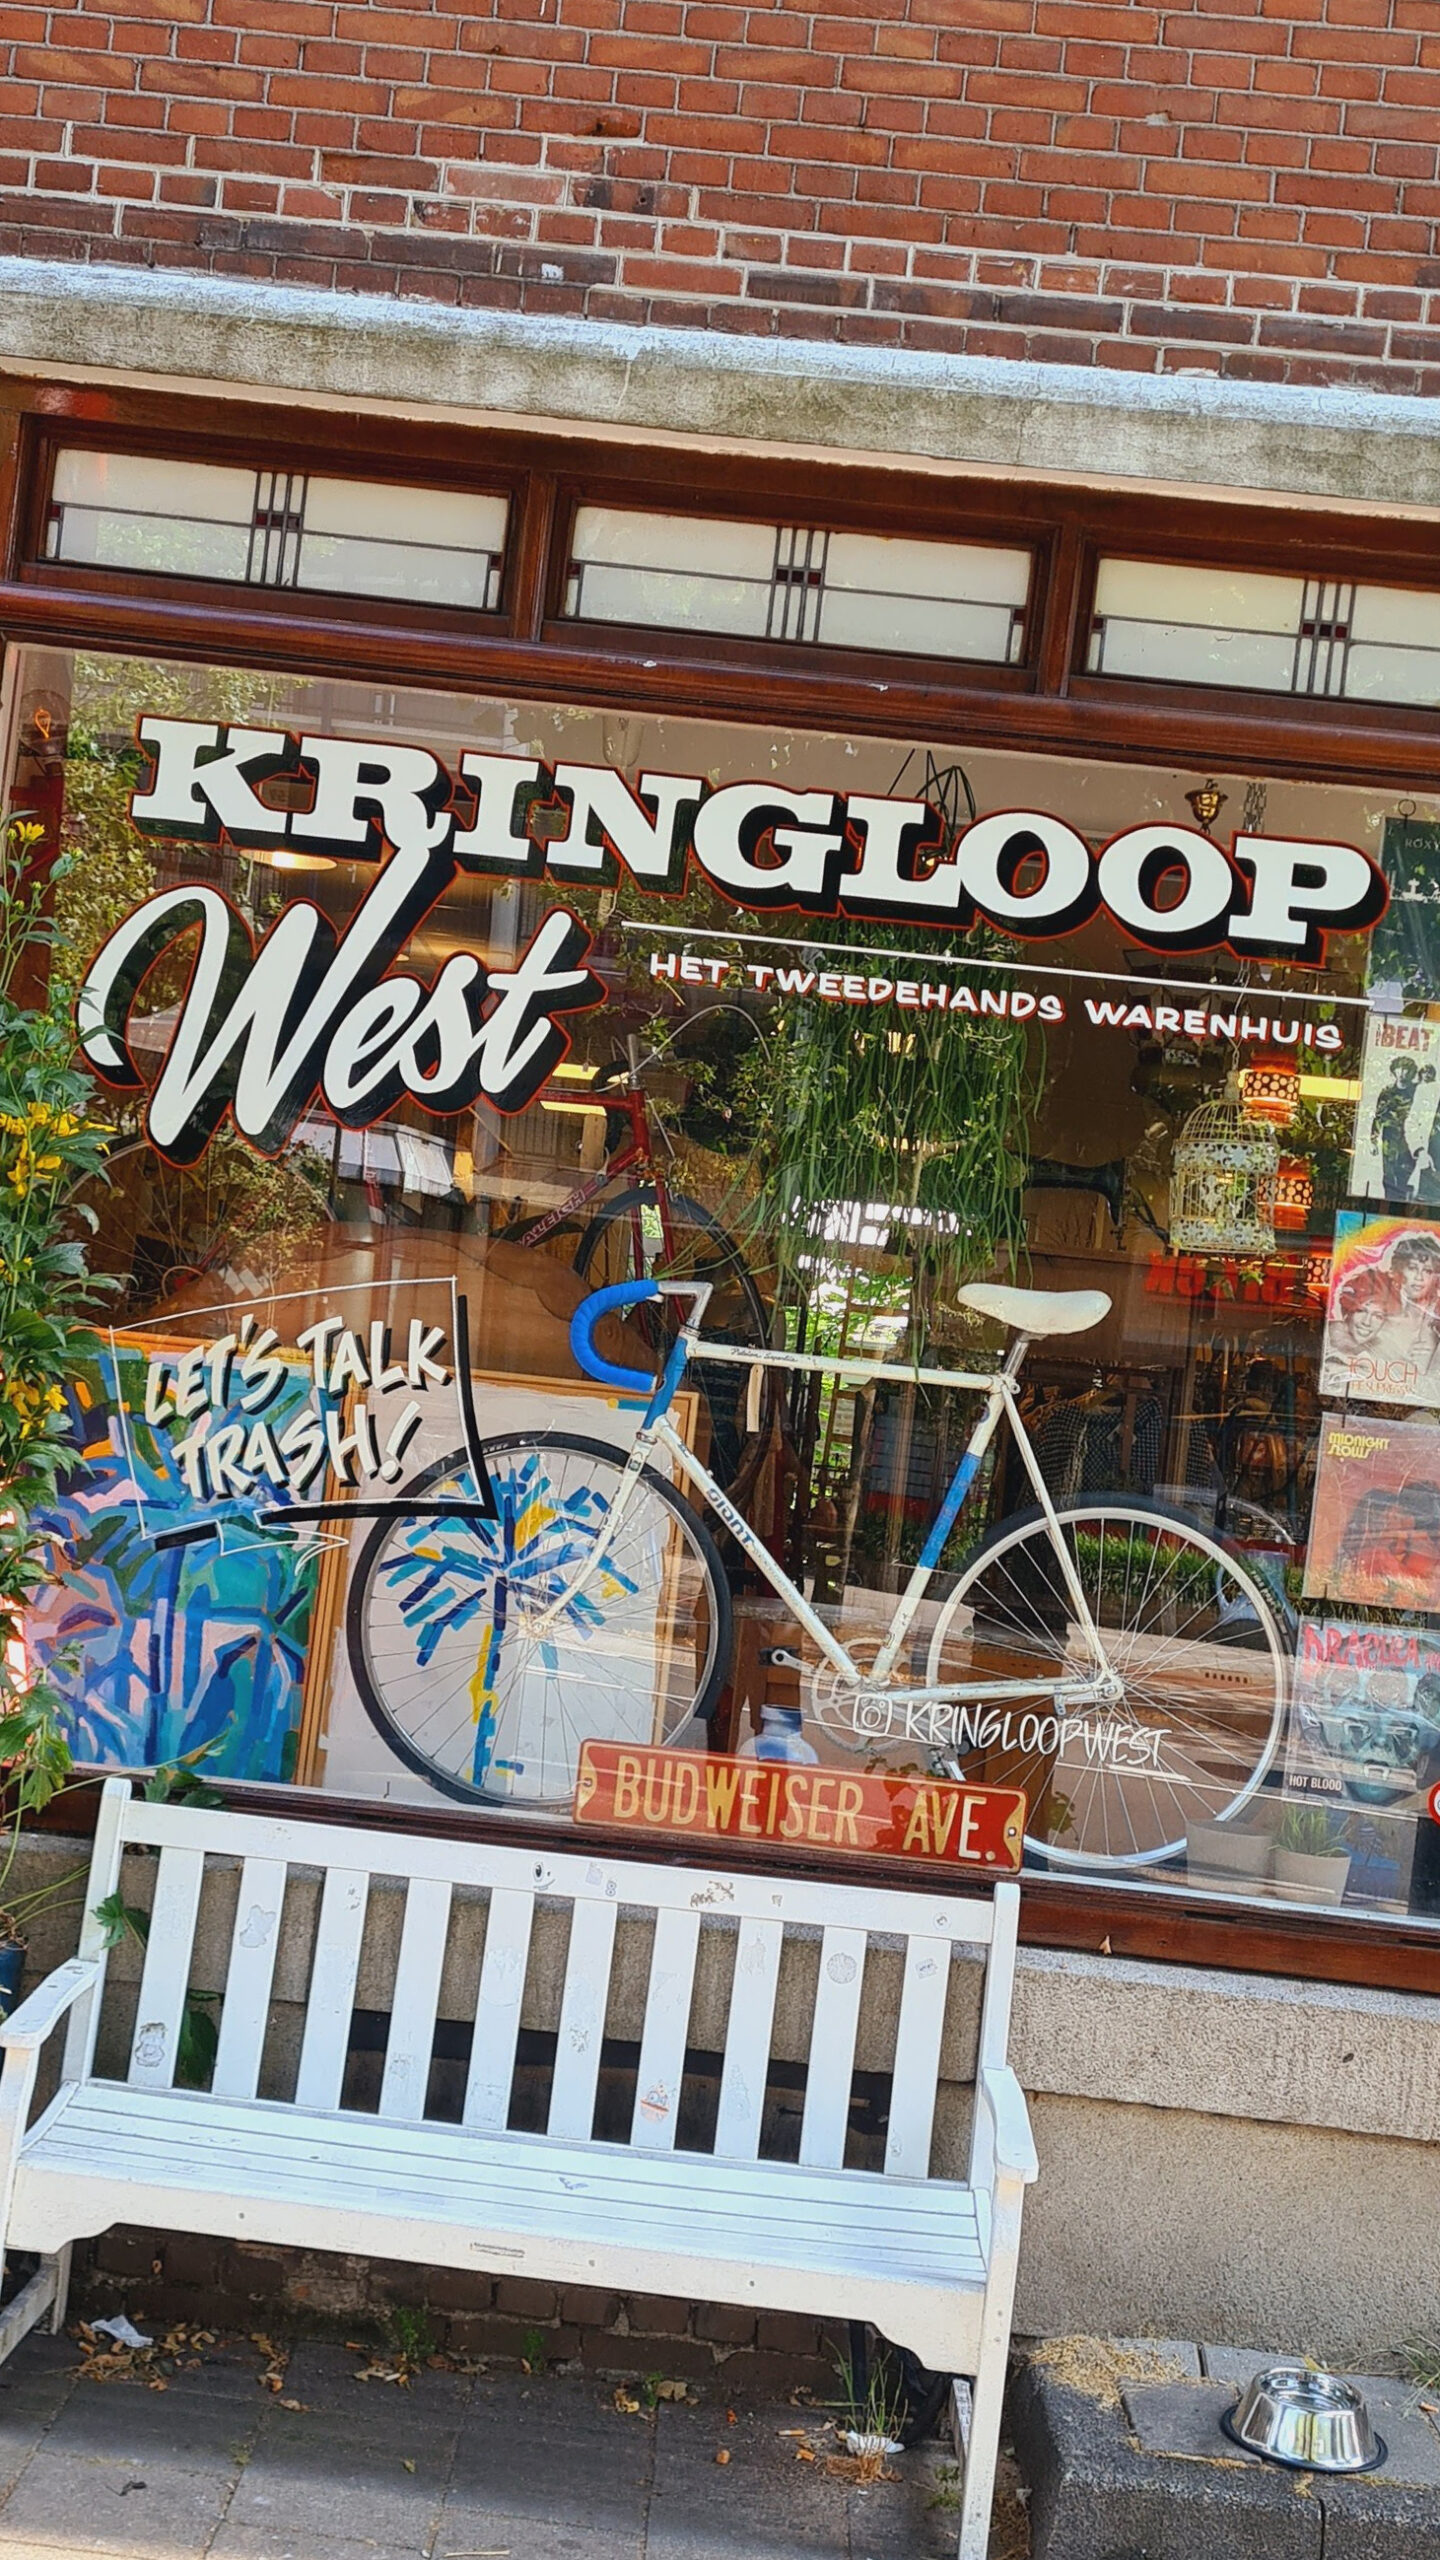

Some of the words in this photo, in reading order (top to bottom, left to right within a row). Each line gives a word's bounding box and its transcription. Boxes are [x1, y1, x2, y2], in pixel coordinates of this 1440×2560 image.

[130, 716, 1380, 952] KRINGLOOP
[77, 852, 588, 1146] West
[650, 953, 730, 988] HET
[747, 963, 1066, 1024] TWEEDEHANDS
[1084, 999, 1344, 1052] WARENHUIS
[1381, 1023, 1434, 1052] BEAT
[144, 1313, 285, 1427] LET'S
[296, 1315, 449, 1394] TALK
[1347, 1356, 1418, 1384] TOUCH
[170, 1400, 421, 1499] TRASH!
[905, 1702, 1173, 1768] KRINGLOOPWEST
[1289, 1774, 1309, 1788] HOT
[1310, 1777, 1342, 1791] BLOOD
[613, 1754, 865, 1846] BUDWEISER
[901, 1789, 997, 1863] AVE.
